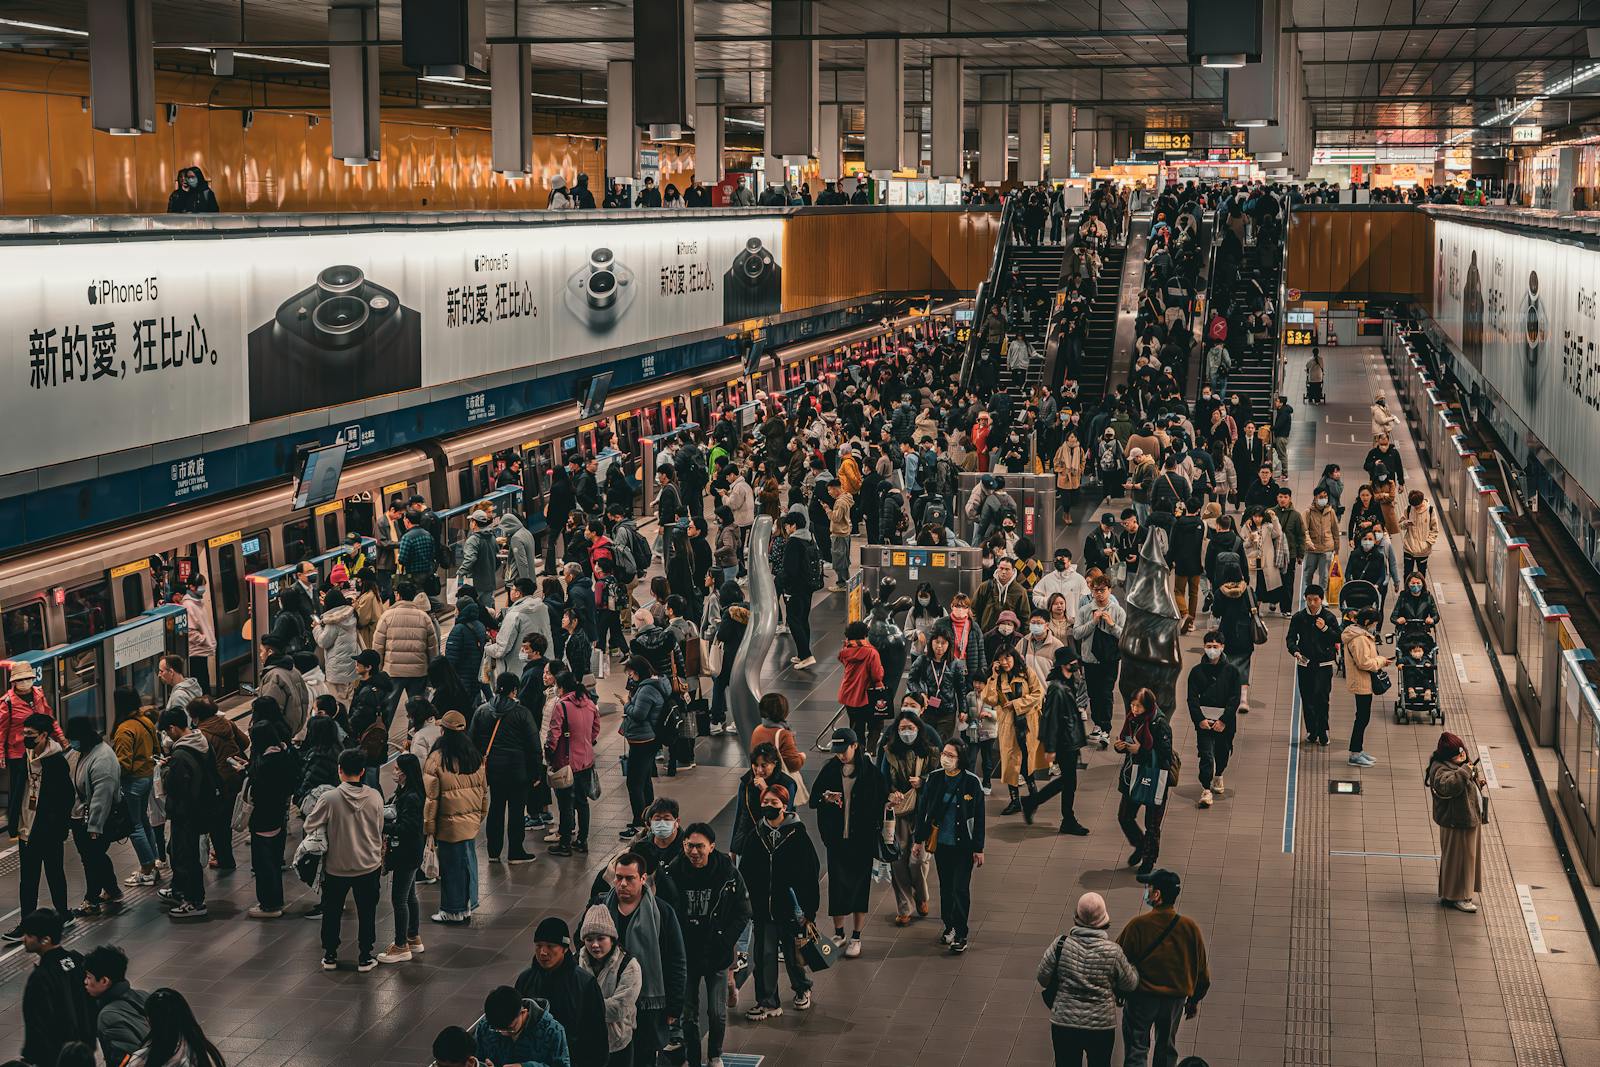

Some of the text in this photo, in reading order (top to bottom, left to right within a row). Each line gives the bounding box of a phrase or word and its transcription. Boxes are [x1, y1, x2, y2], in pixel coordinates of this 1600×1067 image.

[1172, 136, 1182, 149] 3
[98, 276, 159, 305] iPhone 15
[29, 313, 218, 389] 新的愛，狂比心。
[178, 458, 204, 479] 市政府
[274, 580, 279, 593] 3
[182, 614, 188, 627] 3
[36, 666, 43, 682] 3
